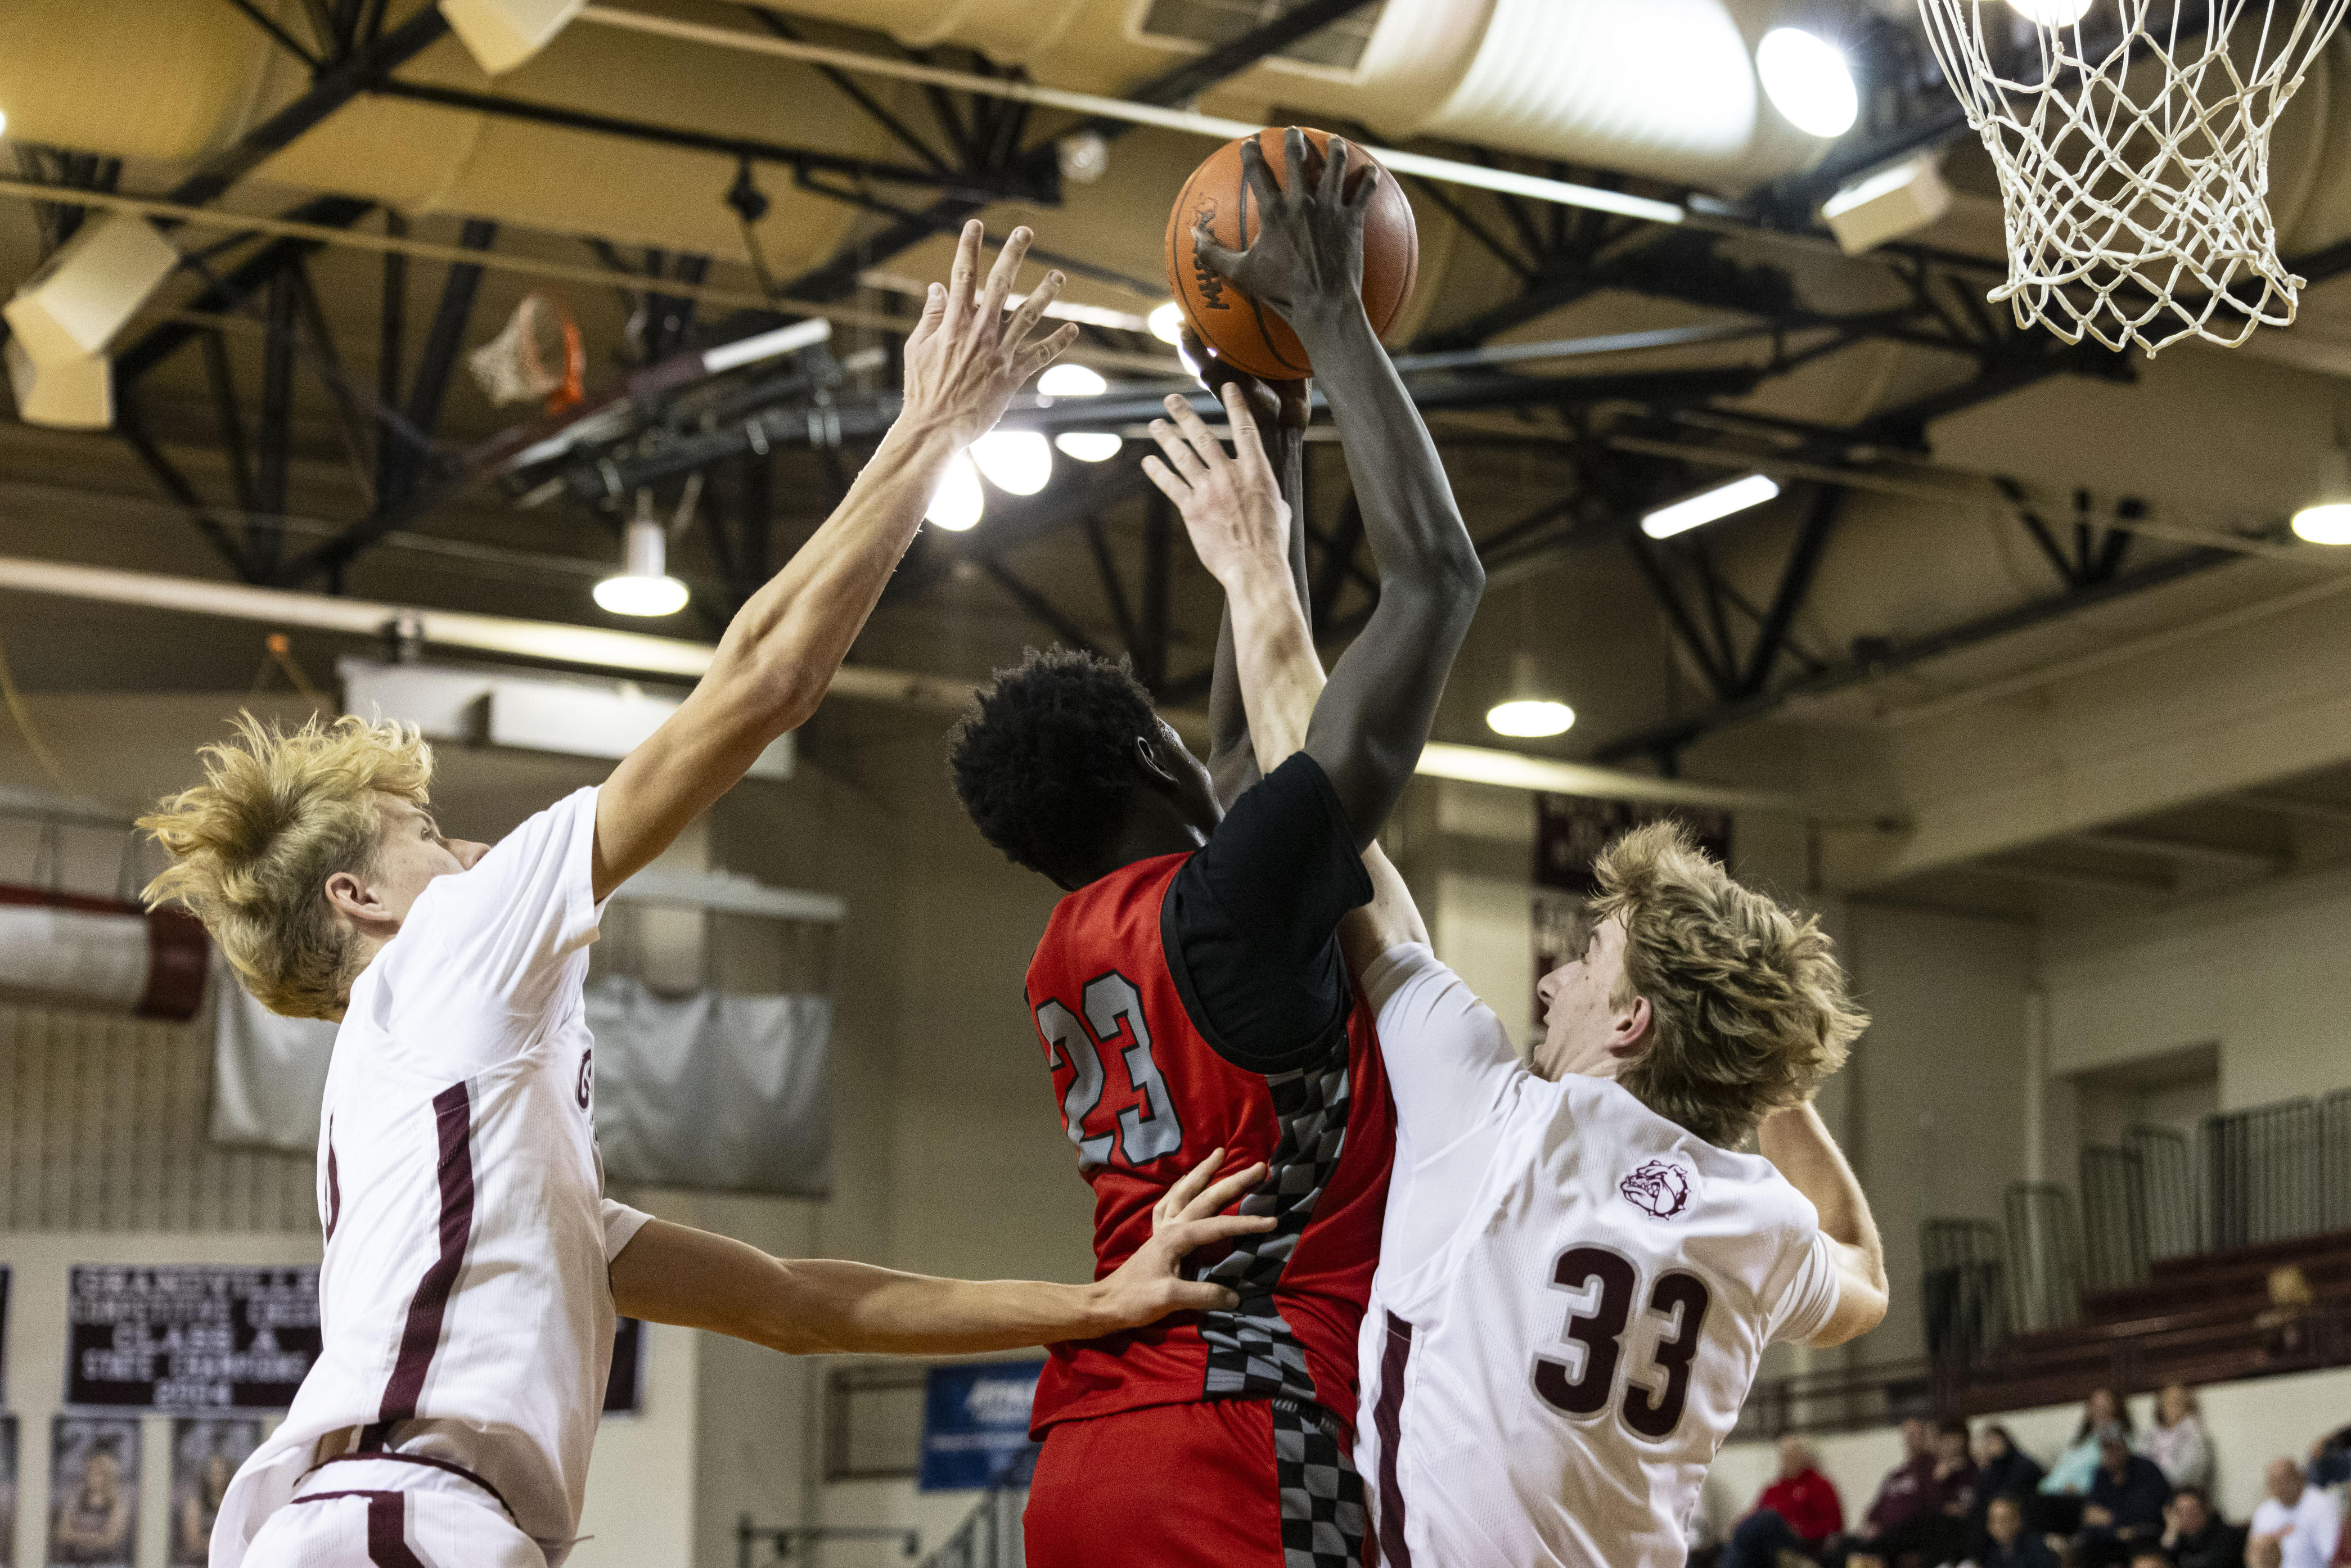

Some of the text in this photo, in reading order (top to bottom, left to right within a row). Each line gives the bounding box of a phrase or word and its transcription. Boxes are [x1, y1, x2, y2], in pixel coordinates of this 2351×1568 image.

[1035, 968, 1183, 1172] 23
[83, 1352, 154, 1379] STATE
[115, 1326, 277, 1353] CLASS A
[1529, 1241, 1715, 1444] 33
